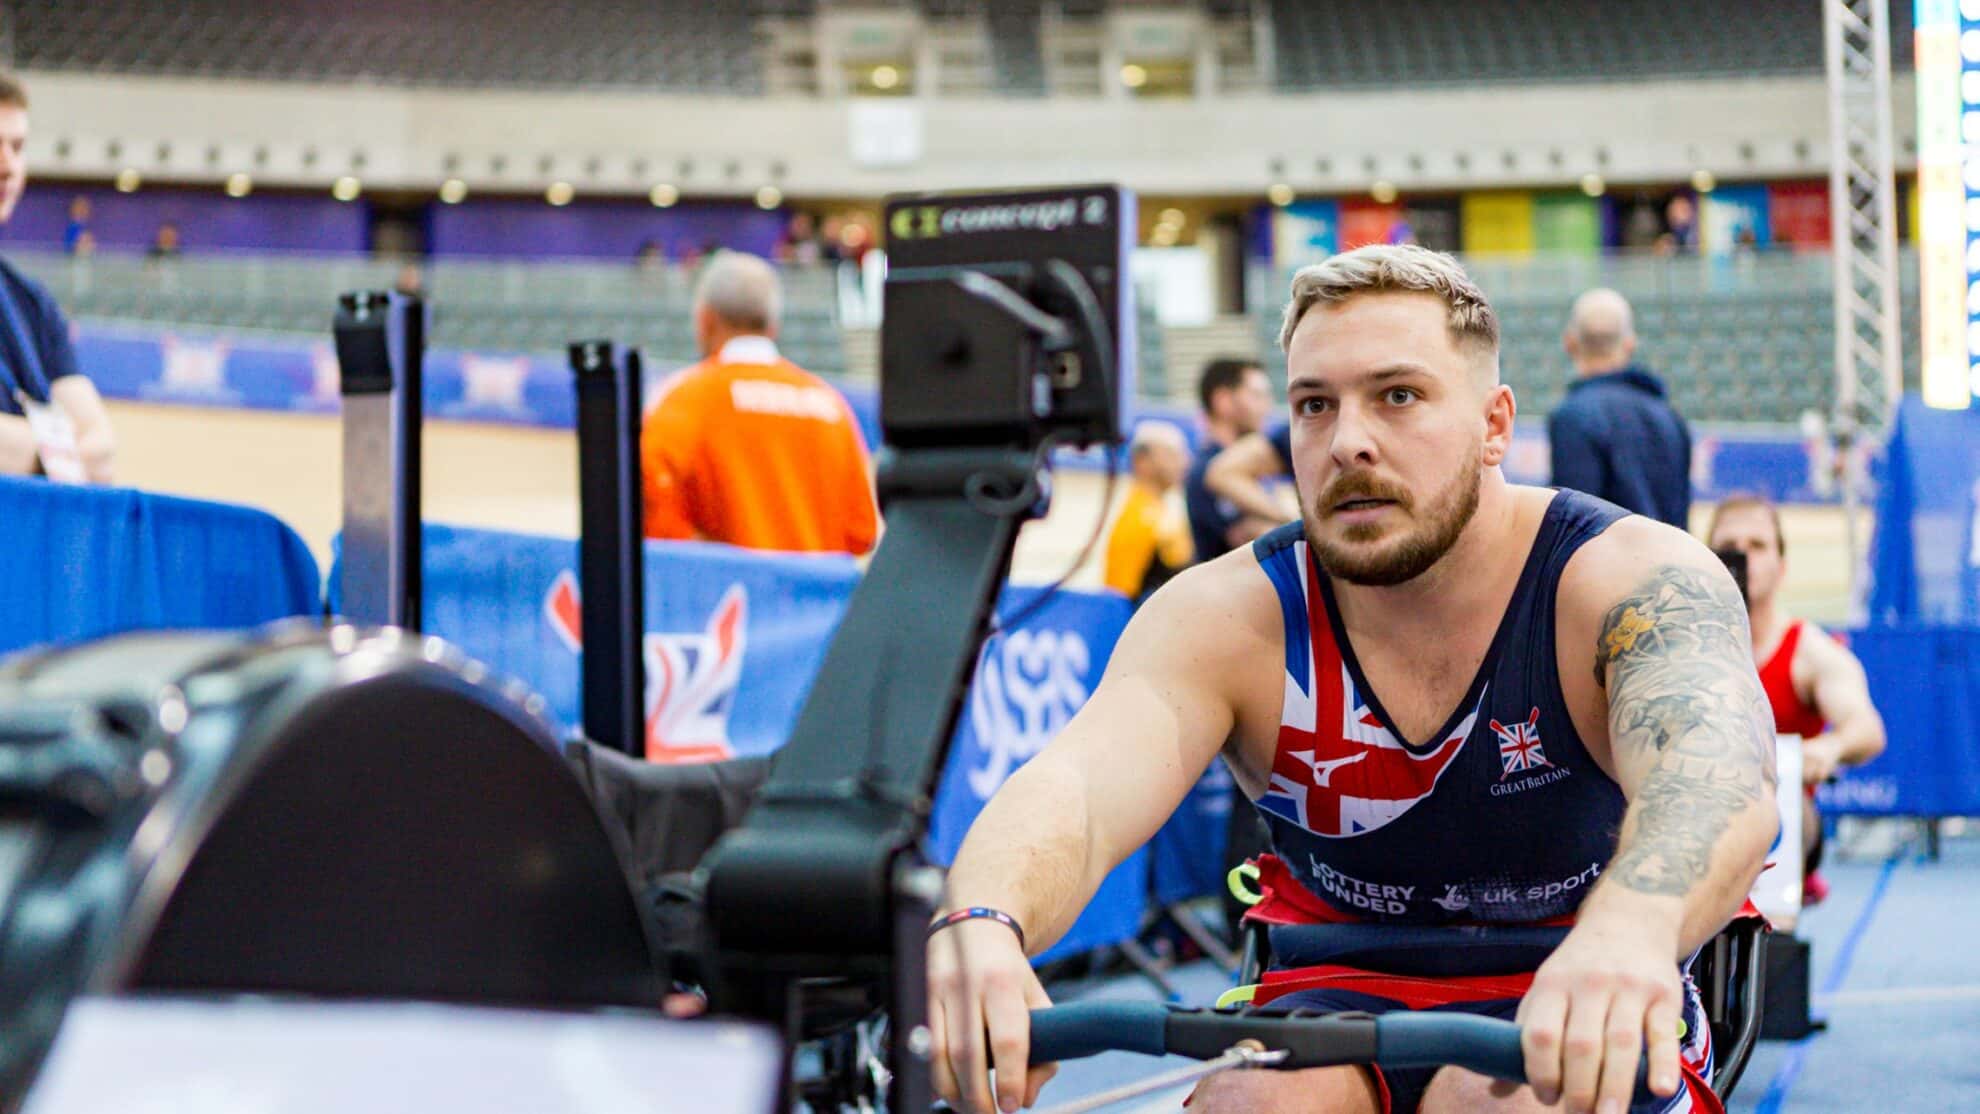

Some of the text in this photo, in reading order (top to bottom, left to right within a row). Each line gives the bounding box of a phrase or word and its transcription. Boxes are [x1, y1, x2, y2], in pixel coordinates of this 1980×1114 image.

[1309, 852, 1417, 901] LOTTERY
[1311, 864, 1407, 915] FUNDED
[1483, 861, 1601, 904] uk sport
